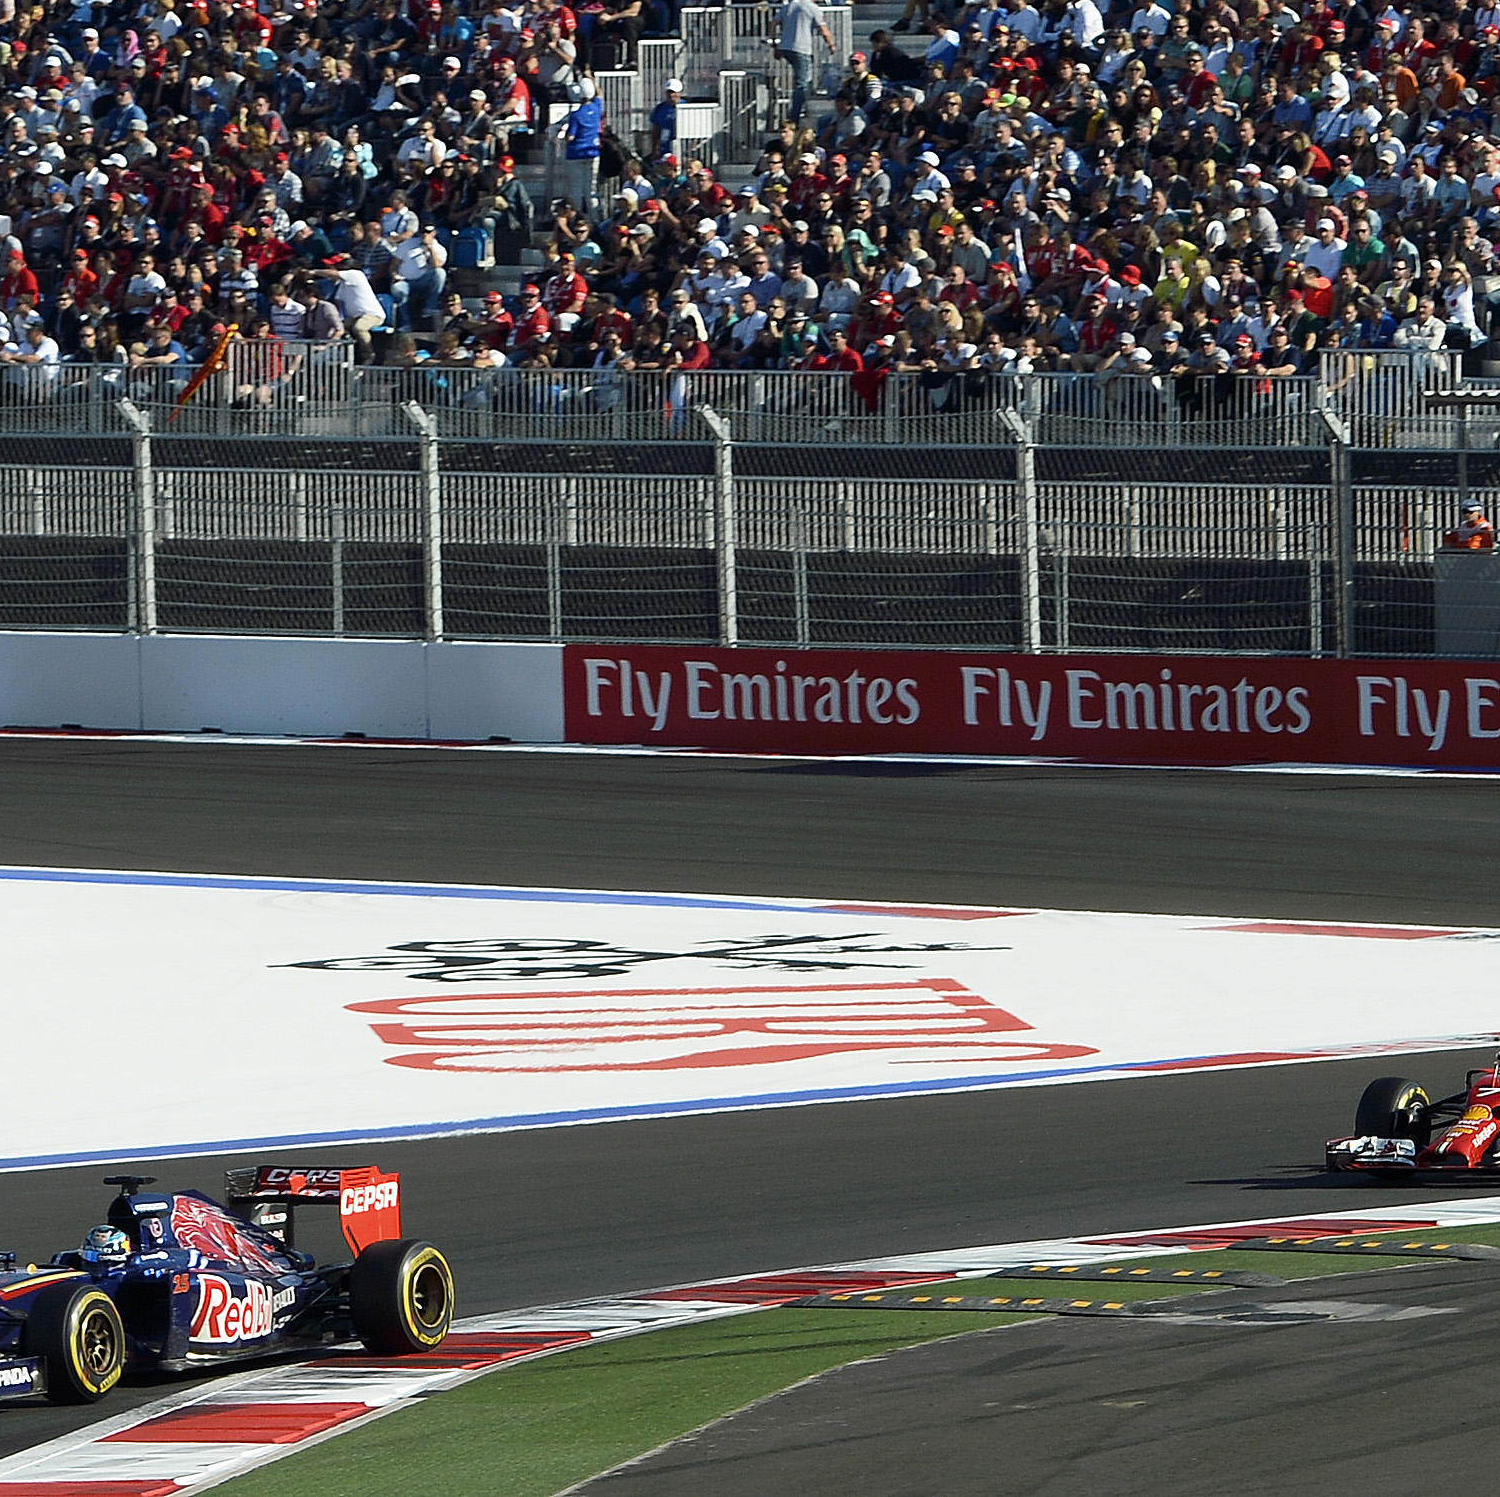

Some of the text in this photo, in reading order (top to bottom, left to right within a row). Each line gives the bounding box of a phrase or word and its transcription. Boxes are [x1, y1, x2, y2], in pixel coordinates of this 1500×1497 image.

[583, 658, 920, 731] Fly Emirates
[961, 666, 1310, 741] Fly Emirates
[1356, 676, 1450, 751] Fly
[341, 1181, 398, 1216] CEPSA
[173, 1273, 190, 1294] 25
